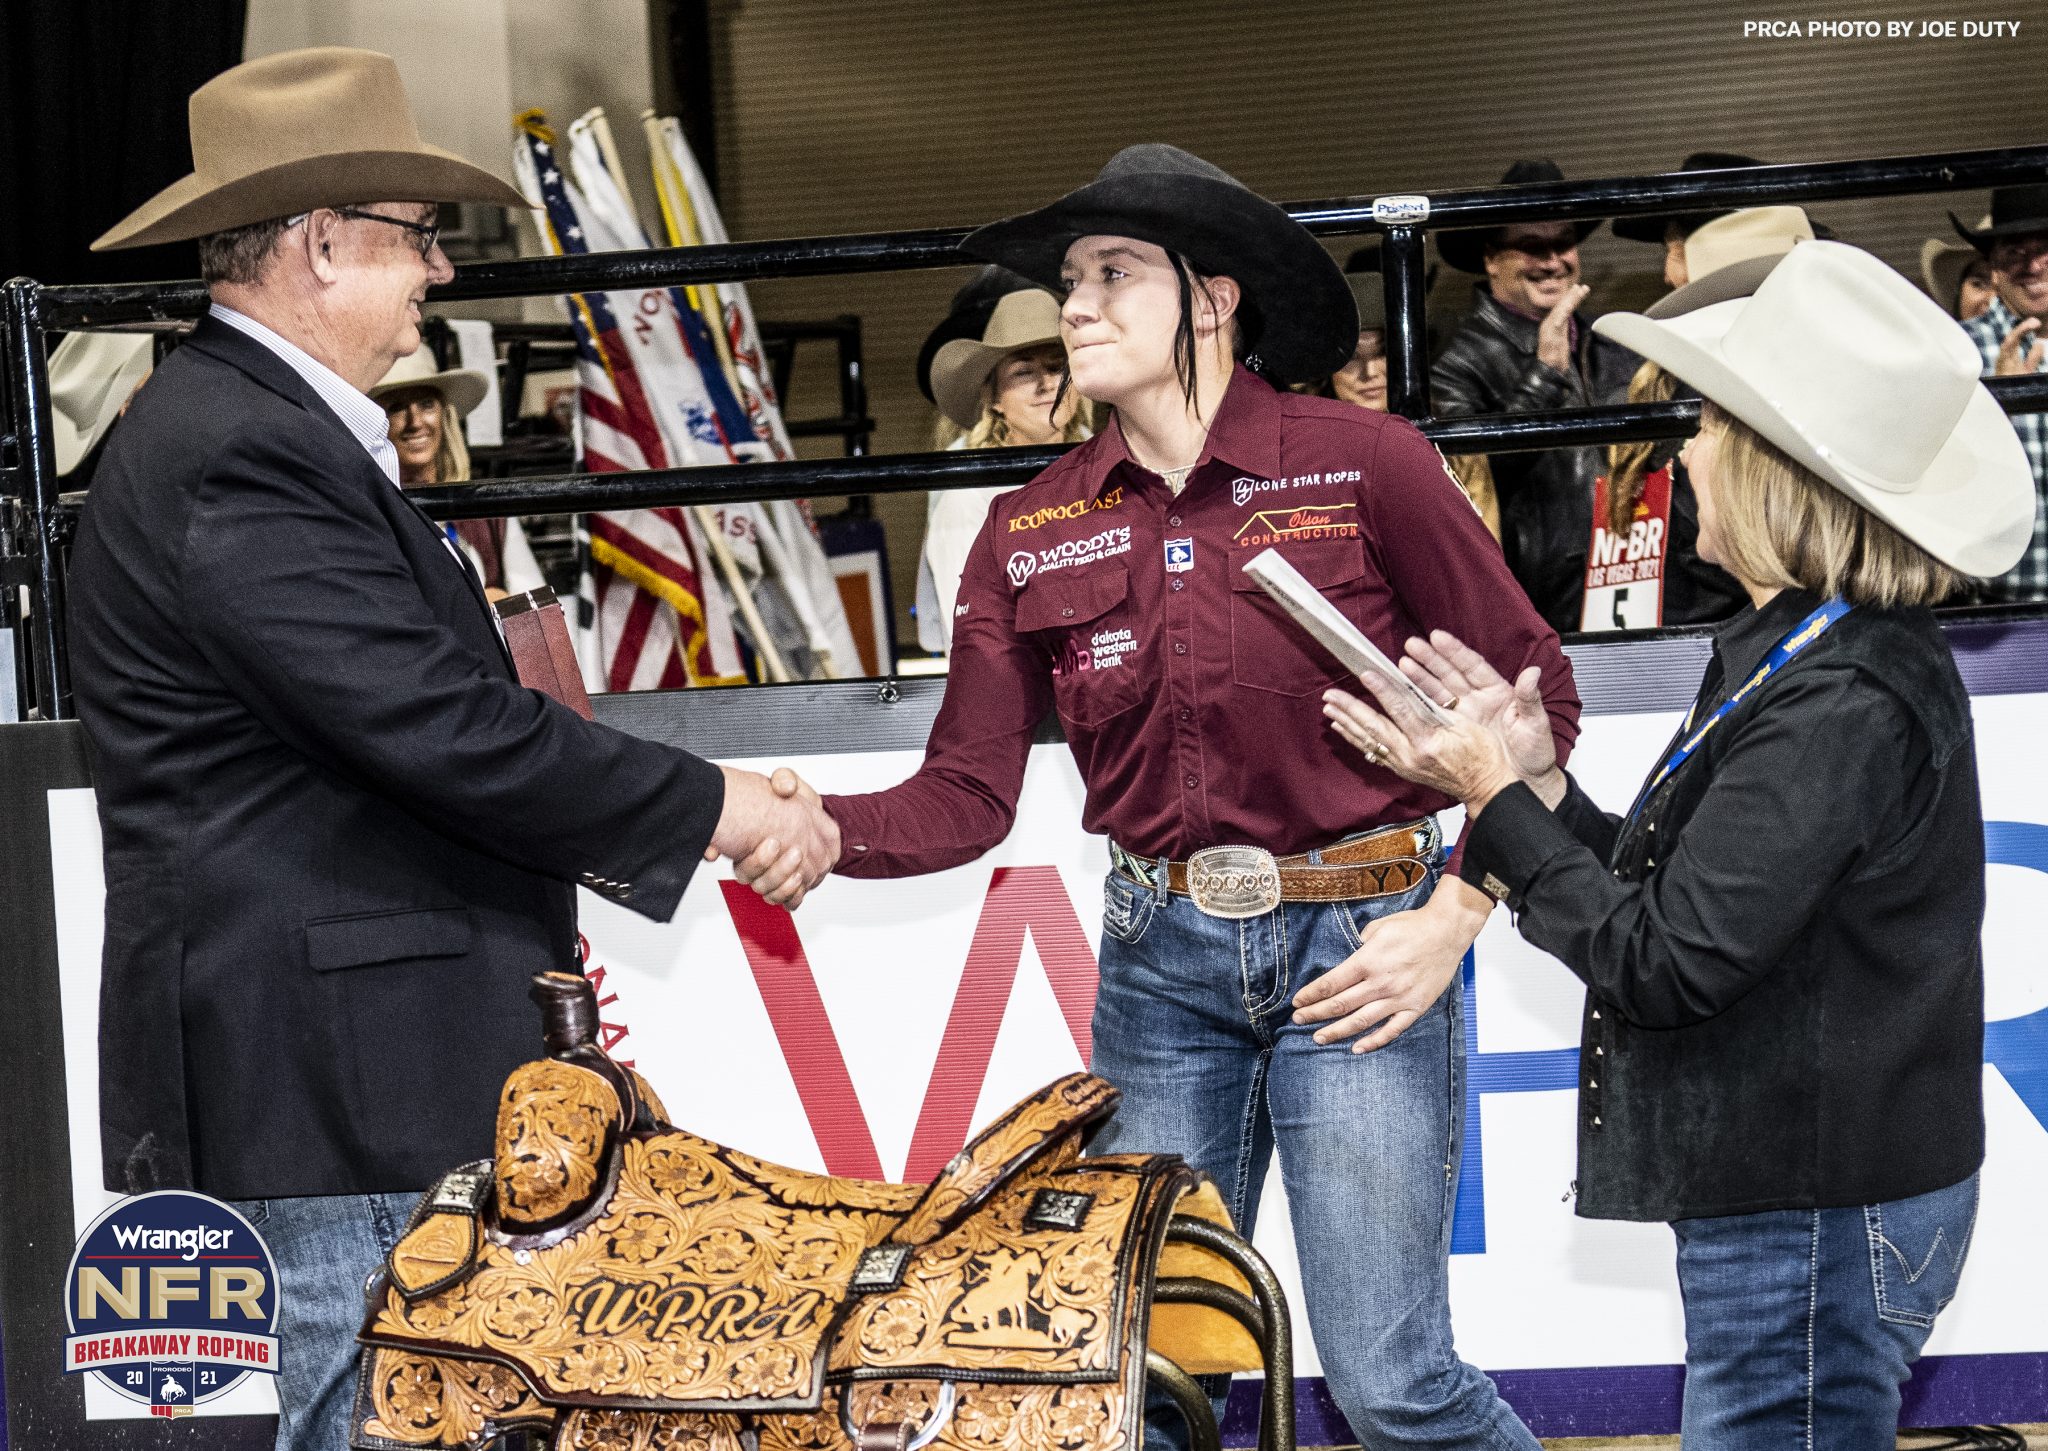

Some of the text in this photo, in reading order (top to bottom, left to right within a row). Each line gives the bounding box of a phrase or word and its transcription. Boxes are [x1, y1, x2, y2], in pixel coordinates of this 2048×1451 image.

[1254, 470, 1361, 491] LONE STAR ROPES
[1008, 486, 1124, 533] ICONOCLAST
[1288, 510, 1331, 528] Olson
[1039, 526, 1131, 563] WOODY'S
[1241, 526, 1359, 547] CONSTRUCTION
[1037, 557, 1075, 574] QUALITY
[1104, 541, 1131, 556] GRAIN
[1587, 567, 1606, 588] LAS
[1091, 629, 1132, 646] dakota
[1091, 640, 1137, 658] western
[1094, 653, 1123, 669] bank
[575, 1281, 821, 1340] WPRA
